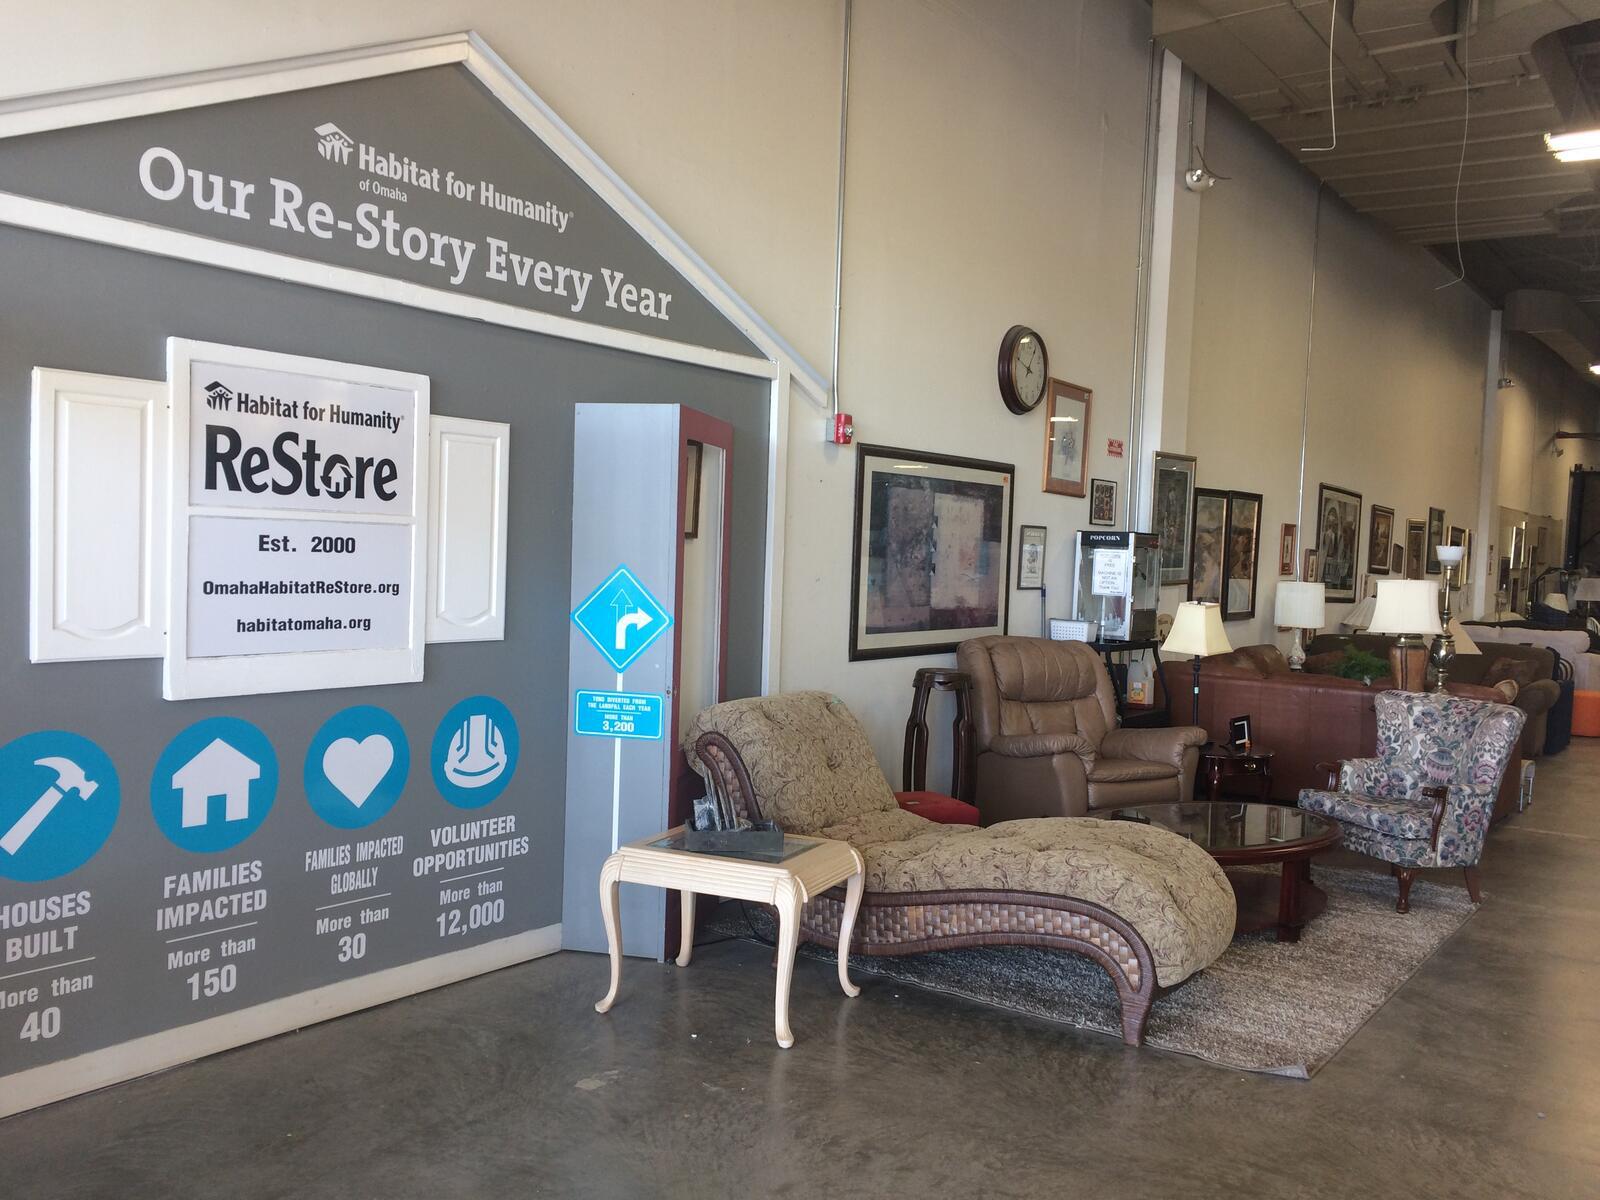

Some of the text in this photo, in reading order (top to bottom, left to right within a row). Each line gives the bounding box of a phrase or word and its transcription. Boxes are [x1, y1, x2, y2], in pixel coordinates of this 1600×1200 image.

[359, 143, 570, 233] Habitat for Humanity
[359, 179, 408, 202] of Omaha
[139, 146, 672, 320] Our Re-Story Every Year
[236, 392, 400, 434] Habitat for Humanity
[204, 424, 398, 501] ReStore
[258, 534, 356, 554] Est. 2000
[202, 580, 400, 596] OmahaHabitatReStore.org
[236, 616, 371, 632] habitatomaha.org
[602, 720, 634, 732] 3,200
[430, 815, 516, 848] VOLUNTEER
[304, 835, 404, 872] FAMILIES IMPACTED
[412, 836, 530, 877] OPPORTUNITIES
[163, 860, 263, 898] FAMILIES
[330, 866, 379, 895] GLOBALLY
[439, 880, 503, 906] More than
[0, 890, 92, 930] HOUSES
[156, 888, 268, 931] IMPACTED
[315, 907, 389, 935] More than
[436, 898, 505, 937] 12,000
[5, 925, 79, 963] BUILT
[167, 937, 256, 970] More than
[337, 932, 367, 963] 30
[51, 973, 94, 997] than
[186, 963, 237, 1001] 150
[19, 1006, 62, 1042] 40
